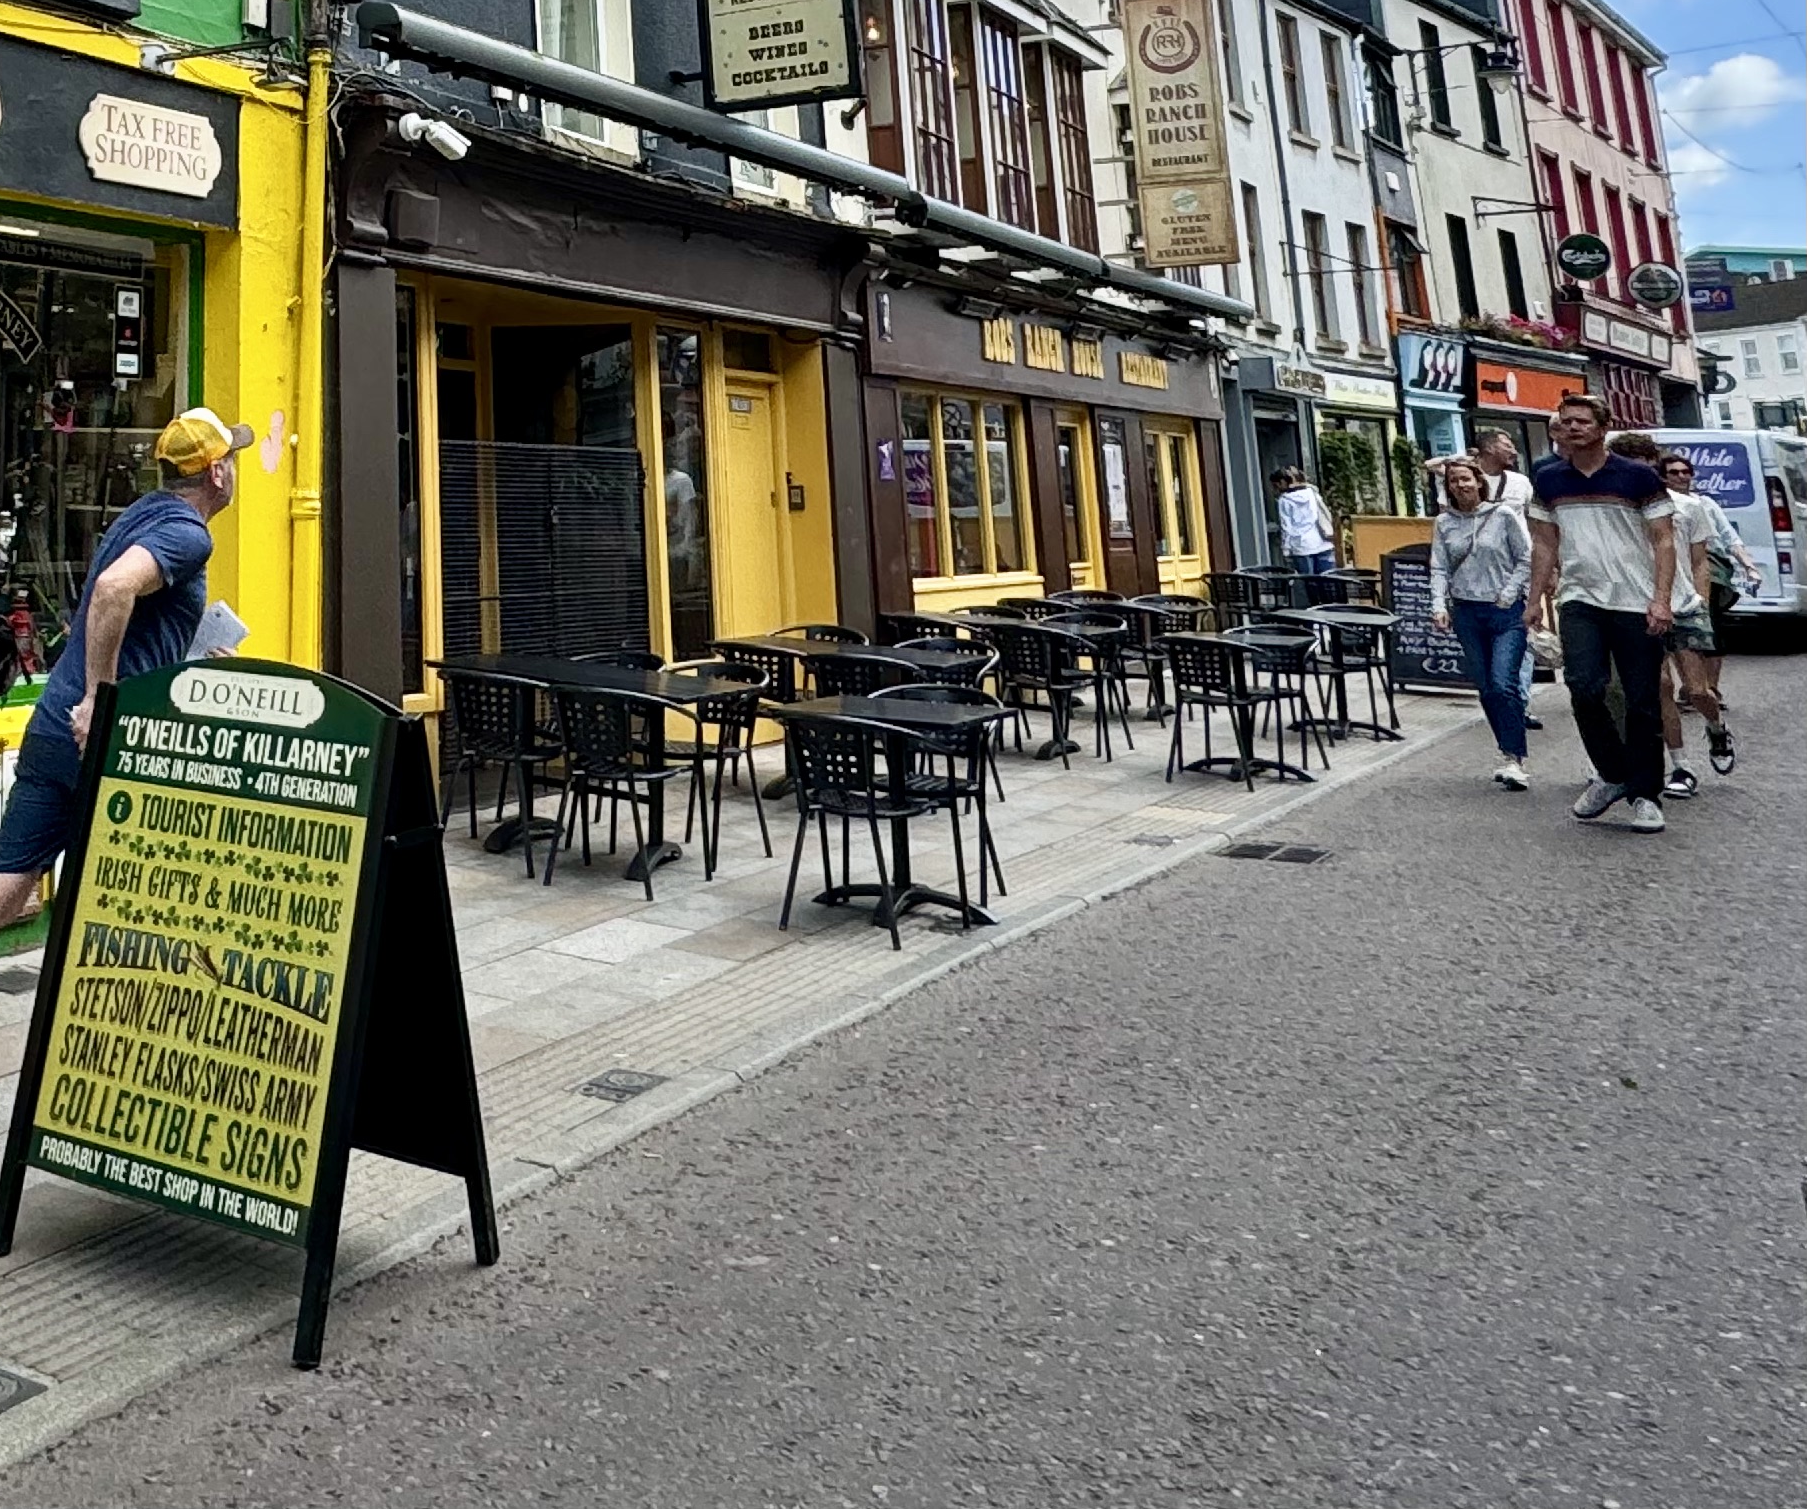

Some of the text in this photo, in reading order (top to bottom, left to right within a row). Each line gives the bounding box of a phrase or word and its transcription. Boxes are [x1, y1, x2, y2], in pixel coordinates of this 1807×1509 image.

[748, 19, 804, 41] BEERS
[748, 41, 808, 62] WINES
[732, 60, 829, 87] COCKTAILS
[1148, 82, 1200, 103] ROBS
[101, 104, 202, 152] TAX FREE
[1146, 103, 1207, 125] RANCH
[1147, 123, 1210, 145] HOUSE
[95, 133, 207, 181] SHOPPING
[1161, 213, 1212, 225] GLUTEN
[1690, 470, 1747, 493] eather
[213, 727, 242, 760] OF
[116, 750, 358, 809] 75 YEARS IN BUSINESS 4TH GENERATION
[139, 793, 354, 865] TOURIST INFORMATION
[95, 854, 343, 935] IRISH GIFTS & MUCH MORE
[76, 921, 335, 1026] FISHING TACKLE
[59, 1023, 133, 1081] STANLEY
[259, 1074, 318, 1132] ARMY
[49, 1073, 309, 1192] COLLECTIBLE SIGNS
[40, 1135, 300, 1236] PROBABLY THE BEST SHOP IN THE WORLD!
